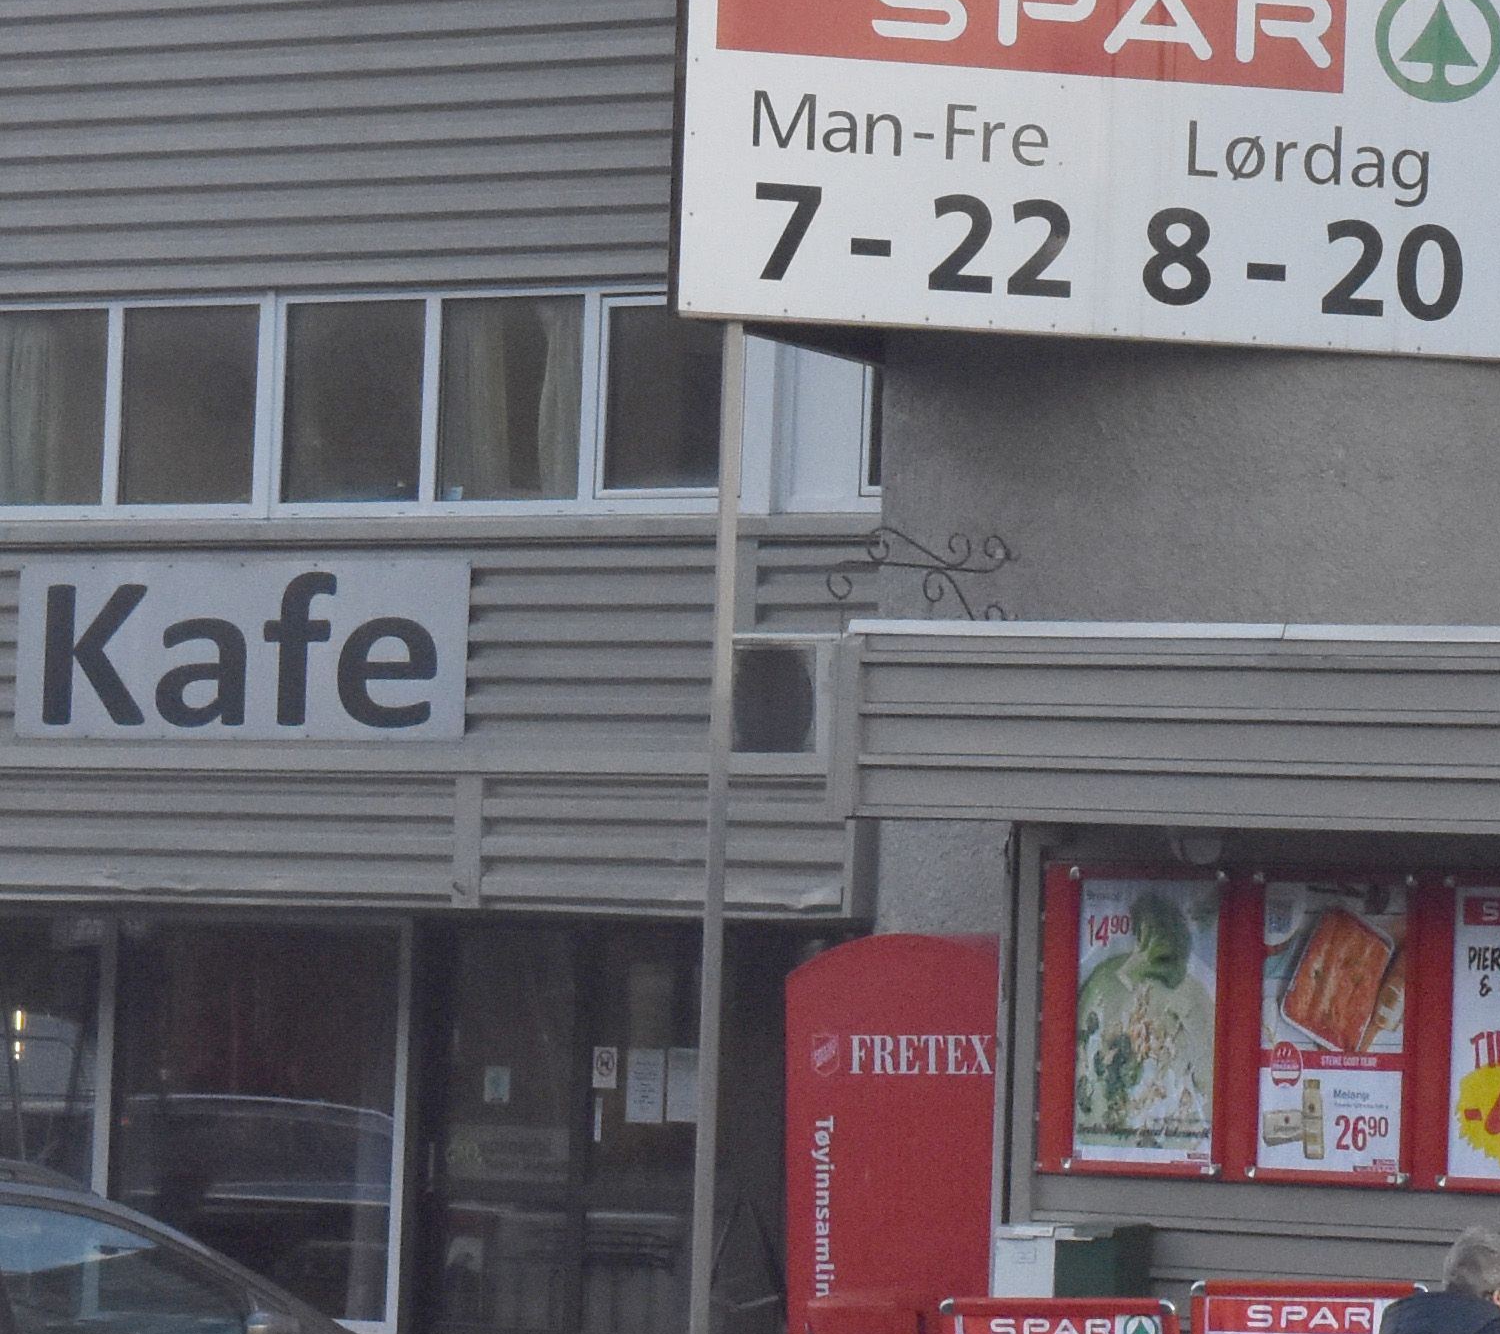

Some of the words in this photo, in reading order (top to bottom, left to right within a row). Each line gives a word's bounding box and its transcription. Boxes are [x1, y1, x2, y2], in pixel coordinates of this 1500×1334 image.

[752, 91, 1049, 166] Man-Fre
[1187, 120, 1430, 207] Lørdag
[42, 571, 438, 728] Kafe
[1479, 975, 1492, 997] &
[849, 1034, 993, 1075] FRETEX
[1247, 1304, 1371, 1329] SPAR
